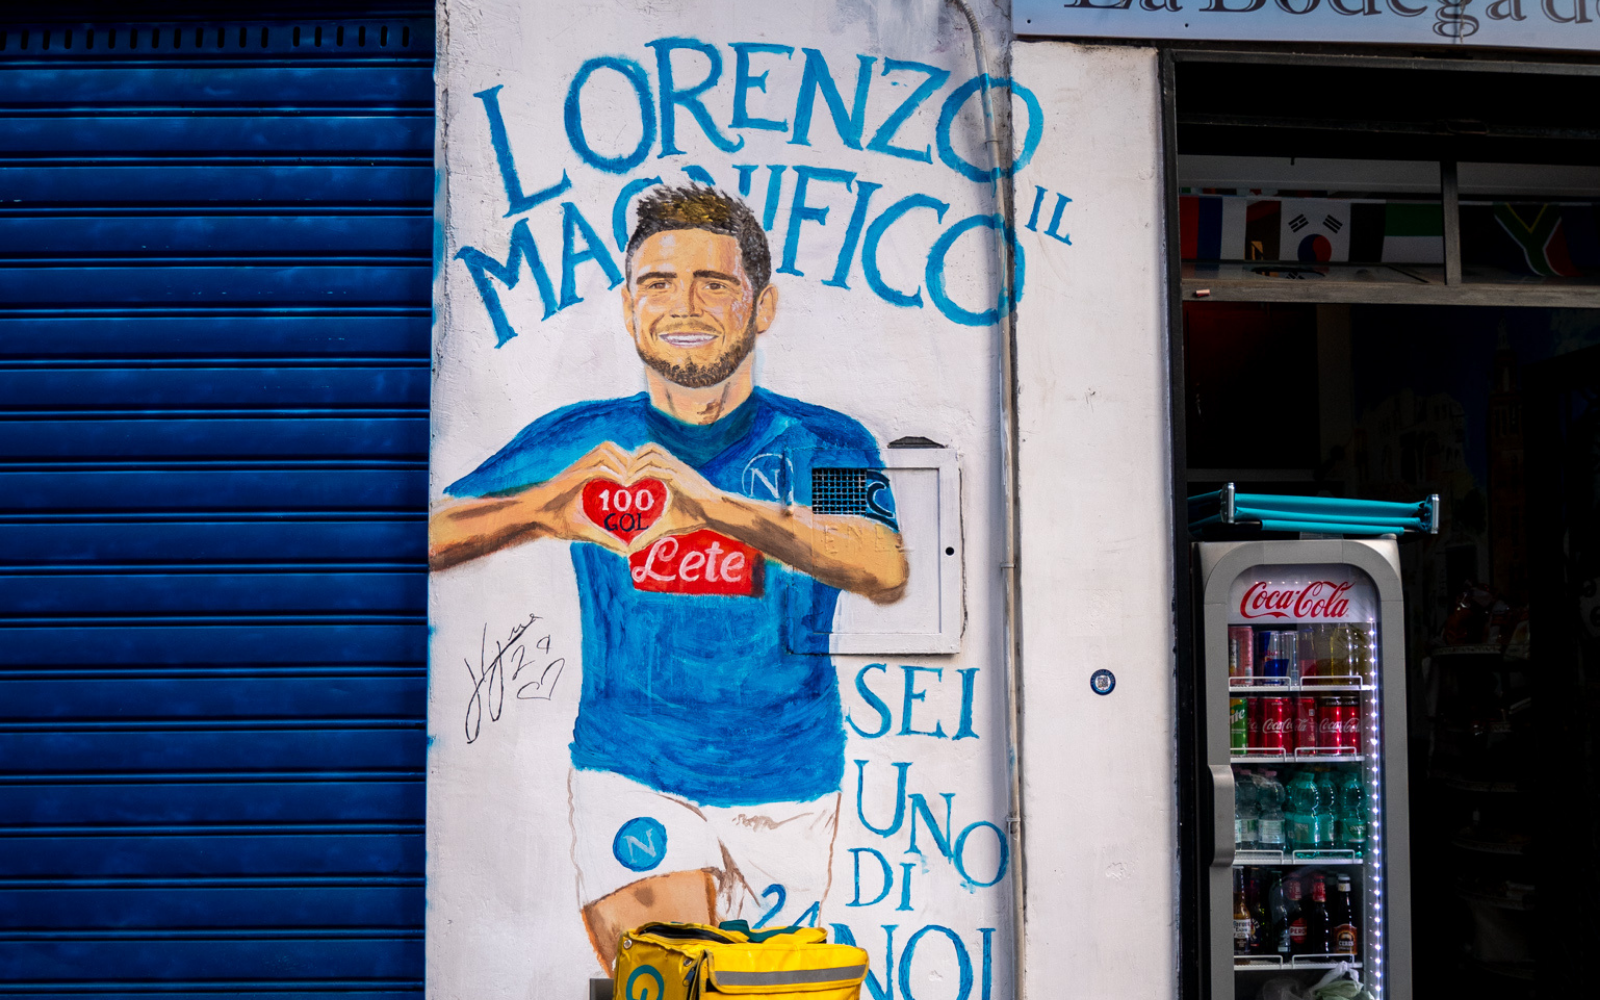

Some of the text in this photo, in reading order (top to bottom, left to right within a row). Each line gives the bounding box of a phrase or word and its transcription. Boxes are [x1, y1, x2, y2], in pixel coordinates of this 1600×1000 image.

[474, 37, 1043, 218] LORENZO
[1025, 185, 1074, 246] IL
[598, 488, 655, 513] 100
[603, 512, 650, 532] GOL
[630, 536, 746, 584] Lete
[1239, 580, 1356, 619] Coca-Cola
[845, 662, 981, 741] SEI
[852, 759, 1010, 889] UNO
[845, 847, 915, 912] DI
[828, 923, 997, 1000] NOI
